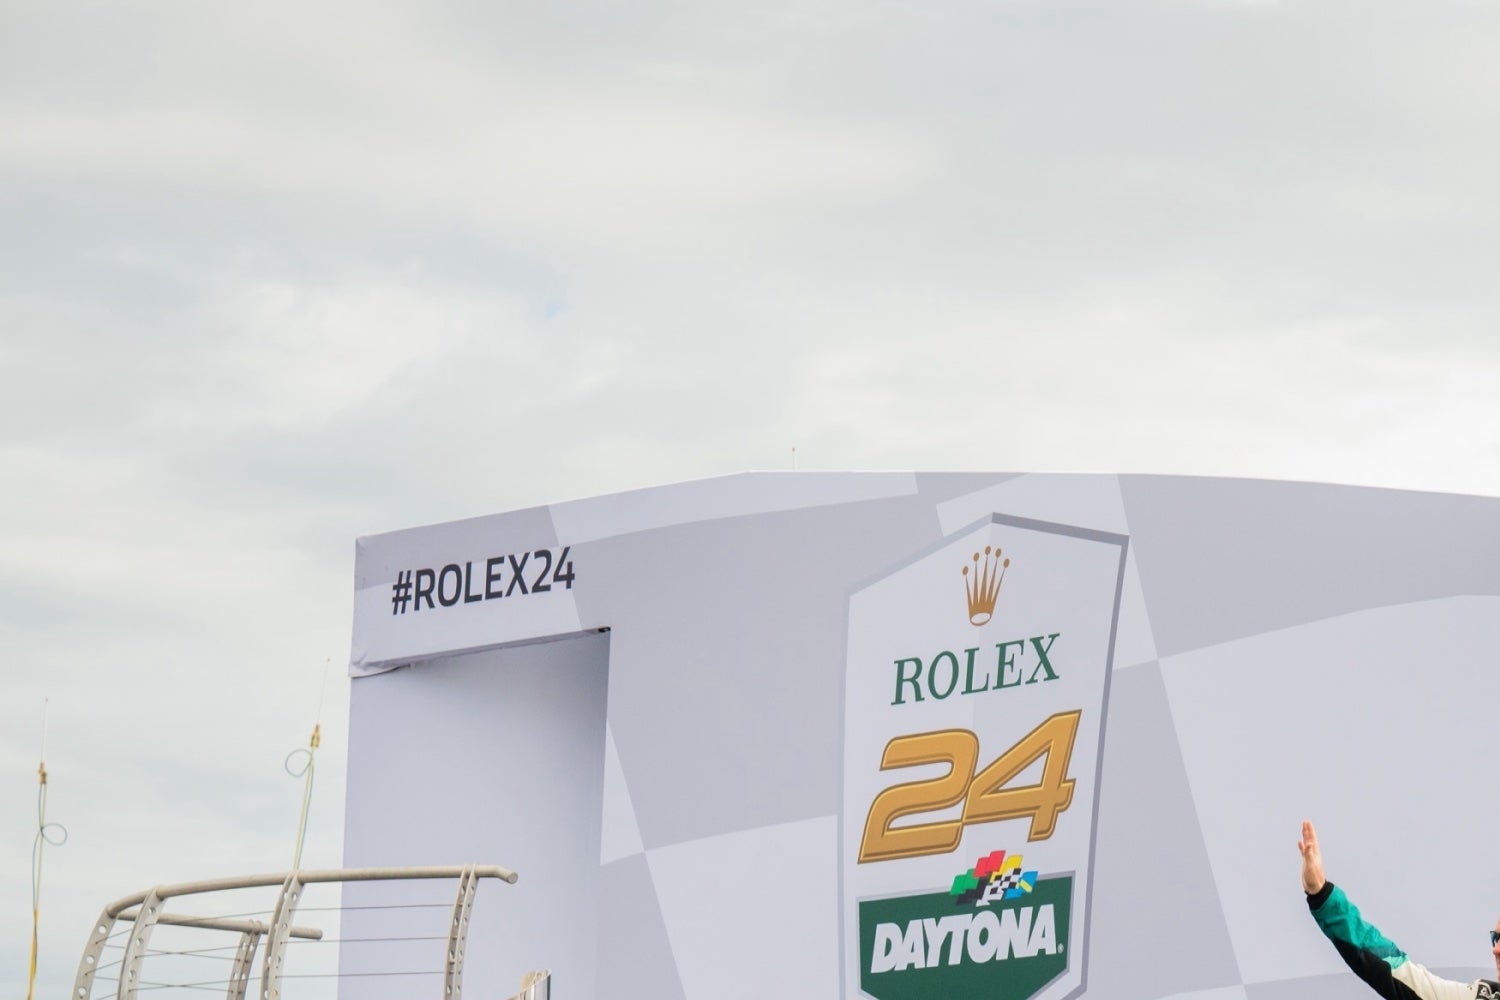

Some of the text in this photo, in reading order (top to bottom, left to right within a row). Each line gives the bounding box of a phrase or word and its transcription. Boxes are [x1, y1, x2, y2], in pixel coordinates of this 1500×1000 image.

[391, 545, 576, 615] #ROLEX24
[890, 632, 1061, 706] ROLEX
[857, 709, 1083, 865] 24
[870, 903, 1061, 974] DAYTONA
